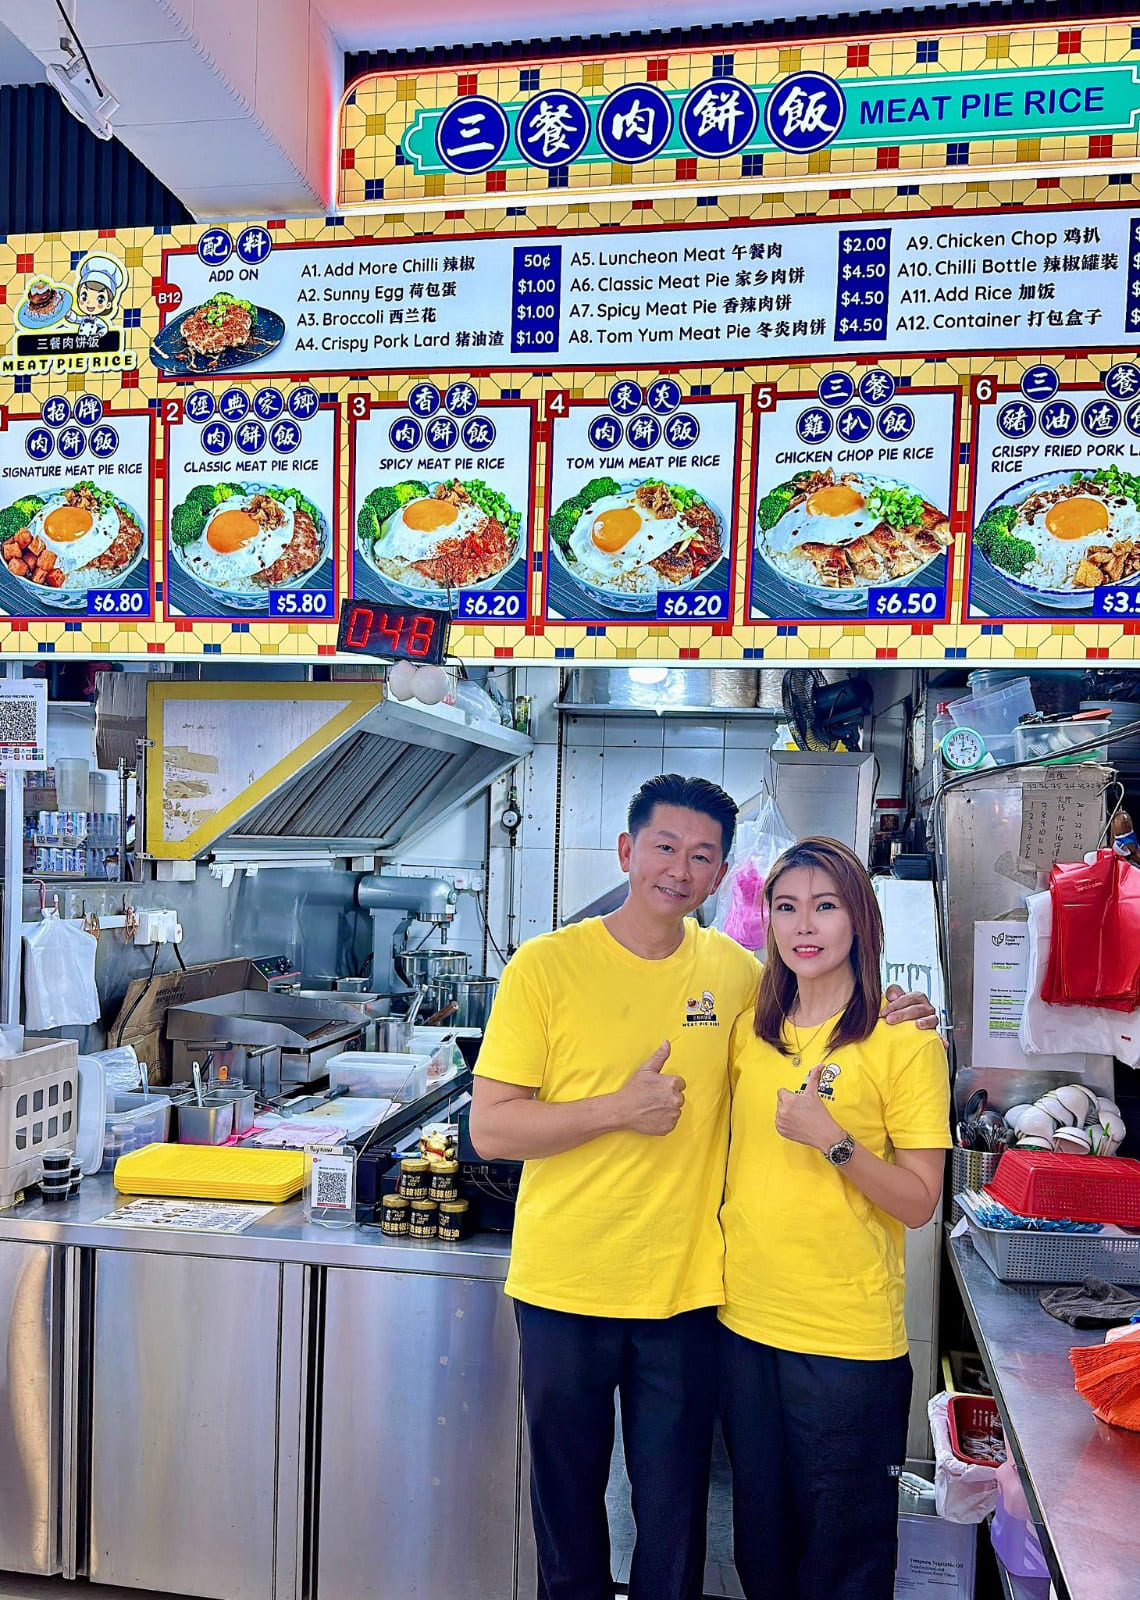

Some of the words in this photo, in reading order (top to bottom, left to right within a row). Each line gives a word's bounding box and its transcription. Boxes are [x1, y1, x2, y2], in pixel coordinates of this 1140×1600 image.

[861, 96, 951, 124] MEAT
[962, 92, 1013, 119] PIE
[1025, 87, 1104, 115] RICE
[446, 88, 837, 157] 三餐肉餅飯
[203, 232, 265, 259] 配料
[843, 237, 885, 253] $2.00
[907, 236, 932, 250] A9.
[937, 232, 1004, 248] Chicken
[1012, 230, 1057, 248] Chop
[1064, 227, 1100, 244] 鸡扒
[525, 254, 550, 269] 50¢
[571, 252, 594, 266] A5.
[600, 250, 677, 265] Luncheon
[684, 248, 725, 262] Meat
[732, 242, 782, 260] 午餐肉
[301, 264, 320, 277] A1.
[324, 262, 353, 277] Add
[359, 262, 397, 275] More
[403, 258, 438, 273] Chilli
[443, 256, 475, 272] 辣椒
[843, 264, 885, 280] $4.50
[898, 262, 931, 277] A10.
[936, 259, 976, 275] Chilli
[983, 257, 1036, 273] Bottle
[1043, 253, 1118, 272] 辣椒罐装
[209, 270, 233, 282] ADD
[239, 269, 258, 280] ON
[570, 278, 594, 291] A6.
[598, 277, 653, 291] Classic
[659, 275, 700, 289] Meat
[706, 274, 729, 287] Pie
[735, 267, 804, 286] 家乡肉饼
[298, 289, 319, 302] A2.
[324, 288, 369, 303] Sunny
[376, 286, 403, 302] Egg
[409, 282, 456, 298] 荷包蛋
[518, 279, 555, 294] $1.00
[901, 289, 930, 304] A11.
[934, 286, 968, 302] Add
[975, 286, 1012, 300] Rice
[1018, 283, 1055, 300] 加饭
[159, 292, 180, 303] B12
[570, 304, 593, 317] A7.
[597, 304, 640, 320] Spicy
[646, 302, 687, 316] Meat
[694, 299, 716, 314] Pie
[723, 294, 792, 313] 香辣肉饼
[841, 291, 883, 307] $4.50
[297, 313, 318, 326] A3.
[323, 310, 383, 326] Broccoli
[390, 307, 436, 324] 西兰花
[518, 305, 554, 320] $1.00
[896, 316, 929, 330] A12.
[934, 313, 1021, 328] Container
[1028, 309, 1101, 327] 打包盒子
[569, 330, 592, 343] A8.
[597, 330, 632, 343] Tom
[639, 329, 673, 342] Yum
[680, 327, 720, 340] Meat
[727, 325, 750, 338] Pie
[757, 319, 826, 338] 冬炎肉饼
[840, 318, 882, 334] $4.50
[295, 338, 318, 350] A4.
[322, 337, 368, 352] Crispy
[374, 334, 408, 348] Pork
[415, 332, 449, 347] Lard
[456, 331, 504, 347] 猪油渣
[517, 330, 553, 346] $1.00
[3, 360, 48, 372] MEAT
[57, 358, 83, 370] PIE
[93, 355, 133, 367] RICE
[823, 373, 890, 401] 三餐
[977, 380, 991, 400] 6
[1026, 367, 1138, 395] 三餐
[189, 391, 315, 416] 經典家鄉
[353, 397, 365, 416] 3
[415, 387, 473, 412] 香辣
[550, 394, 564, 413] 4
[758, 388, 771, 408] 5
[47, 398, 99, 422] 招牌
[167, 403, 178, 421] 2
[395, 420, 492, 446] 肉餅飯
[595, 419, 696, 445] 肉餅飯
[801, 410, 910, 438] 雞扒飯
[31, 430, 116, 455] 肉餅飯
[207, 425, 298, 450] 肉餅飯
[776, 451, 832, 463] CHICKEN
[838, 449, 873, 461] CHOP
[879, 448, 898, 460] PIE
[903, 448, 933, 459] RICE
[992, 445, 1040, 457] CRISPY
[1045, 445, 1081, 456] FRIED
[1087, 444, 1124, 456] PORK
[1130, 444, 1140, 456] L
[2, 466, 61, 477] SIGNATURE
[65, 465, 94, 475] MEAT
[99, 464, 114, 475] PIE
[118, 463, 142, 474] RICE
[184, 461, 231, 472] CLASSIC
[236, 461, 267, 471] MEAT
[272, 460, 288, 471] PIE
[293, 460, 318, 470] RICE
[380, 459, 413, 469] SPICY
[418, 458, 451, 469] MEAT
[456, 458, 472, 469] PIE
[477, 458, 504, 469] RICE
[567, 458, 594, 469] TOM
[600, 458, 624, 468] YUM
[629, 457, 664, 468] MEAT
[669, 456, 686, 467] PIE
[692, 455, 720, 467] RICE
[992, 461, 1022, 472] RICE
[95, 593, 142, 611] $6.80
[277, 594, 326, 612] $5.80
[465, 596, 519, 615] $6.20
[664, 595, 721, 615] $6.20
[876, 593, 936, 614] $6.50
[345, 607, 433, 657] 048
